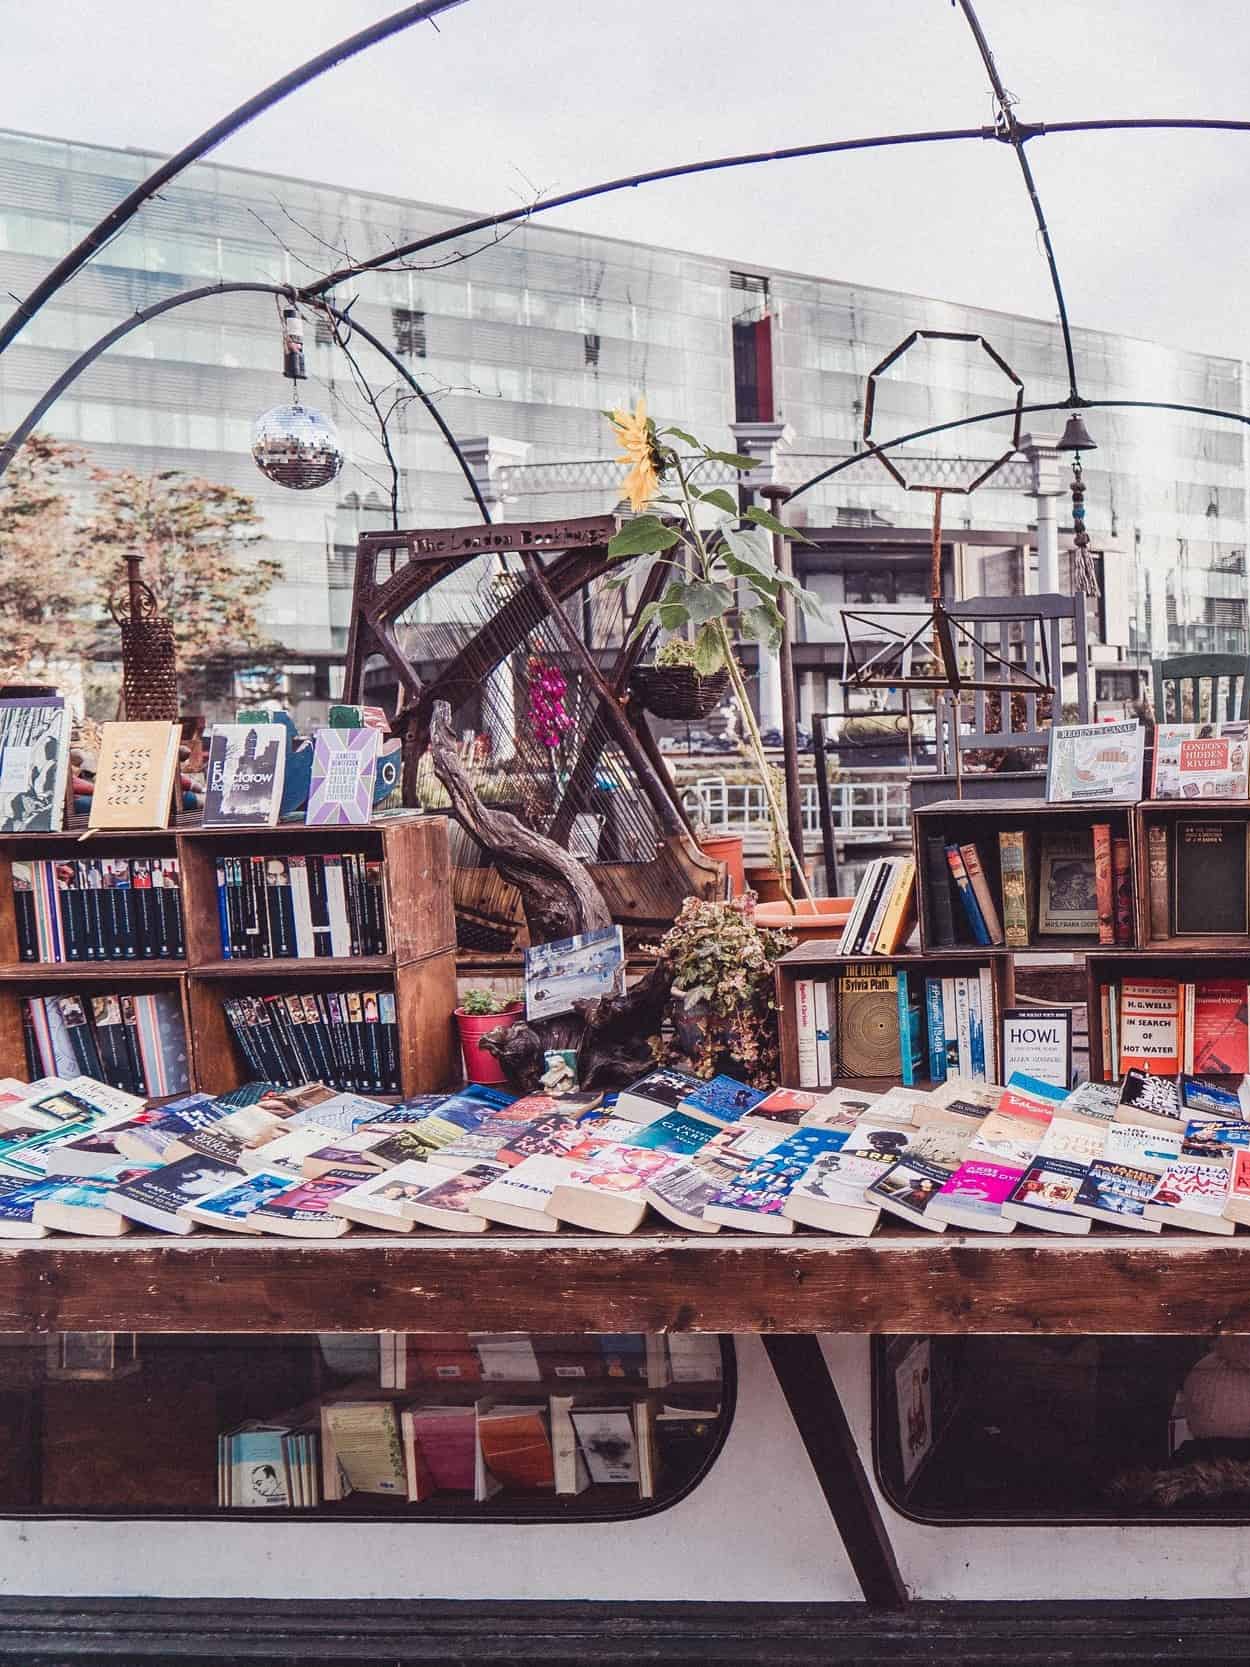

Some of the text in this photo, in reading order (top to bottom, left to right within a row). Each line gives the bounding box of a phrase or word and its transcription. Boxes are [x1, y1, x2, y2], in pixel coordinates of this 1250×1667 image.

[451, 531, 513, 550] London
[1138, 1019, 1171, 1027] SEARCH
[1010, 1028, 1060, 1043] HOWL
[1142, 1046, 1173, 1054] WATER
